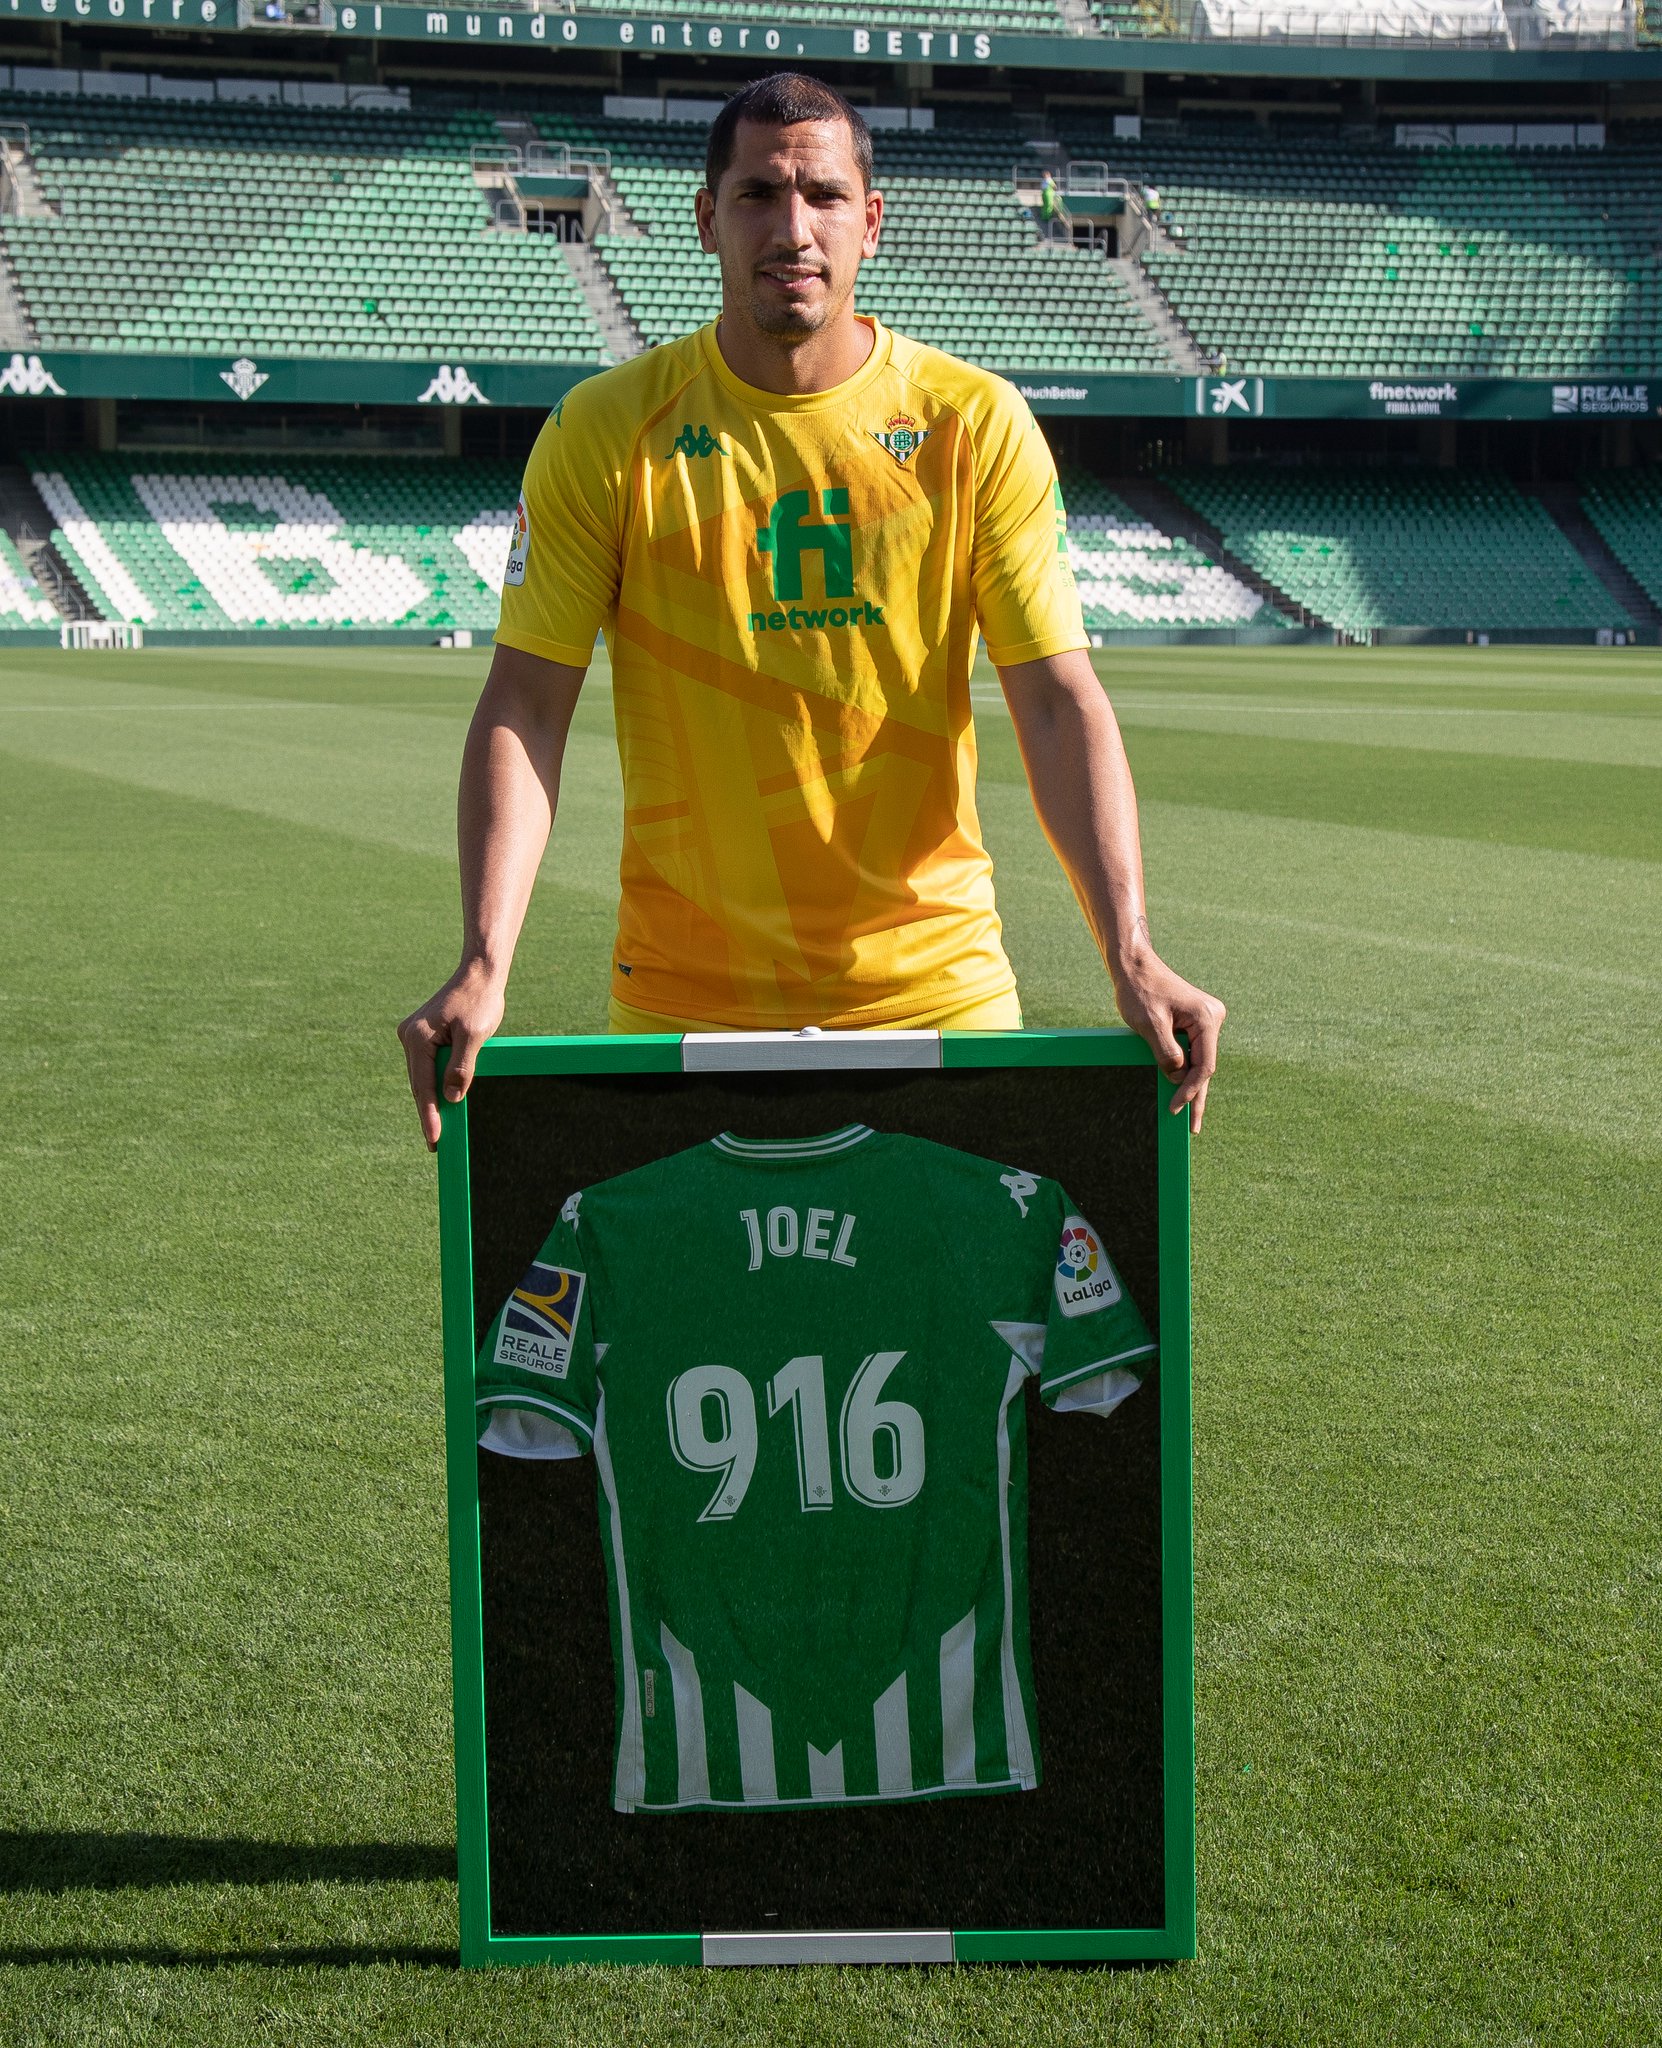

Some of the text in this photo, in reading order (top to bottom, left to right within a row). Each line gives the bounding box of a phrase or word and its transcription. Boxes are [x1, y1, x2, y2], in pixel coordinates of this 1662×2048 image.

[341, 4, 382, 31] el
[426, 12, 578, 41] mundo
[619, 21, 804, 55] entero,
[853, 28, 992, 59] BETIS
[1020, 386, 1088, 400] MuchBetter
[1369, 382, 1457, 400] finetwork
[1580, 385, 1648, 401] REALE
[1580, 401, 1648, 413] SEGUROS
[747, 601, 886, 632] network
[740, 1206, 857, 1271] JOEL
[1063, 1279, 1112, 1304] LaLiga
[502, 1335, 567, 1362] REALE
[500, 1350, 564, 1374] SEGUROS
[666, 1351, 926, 1522] 916
